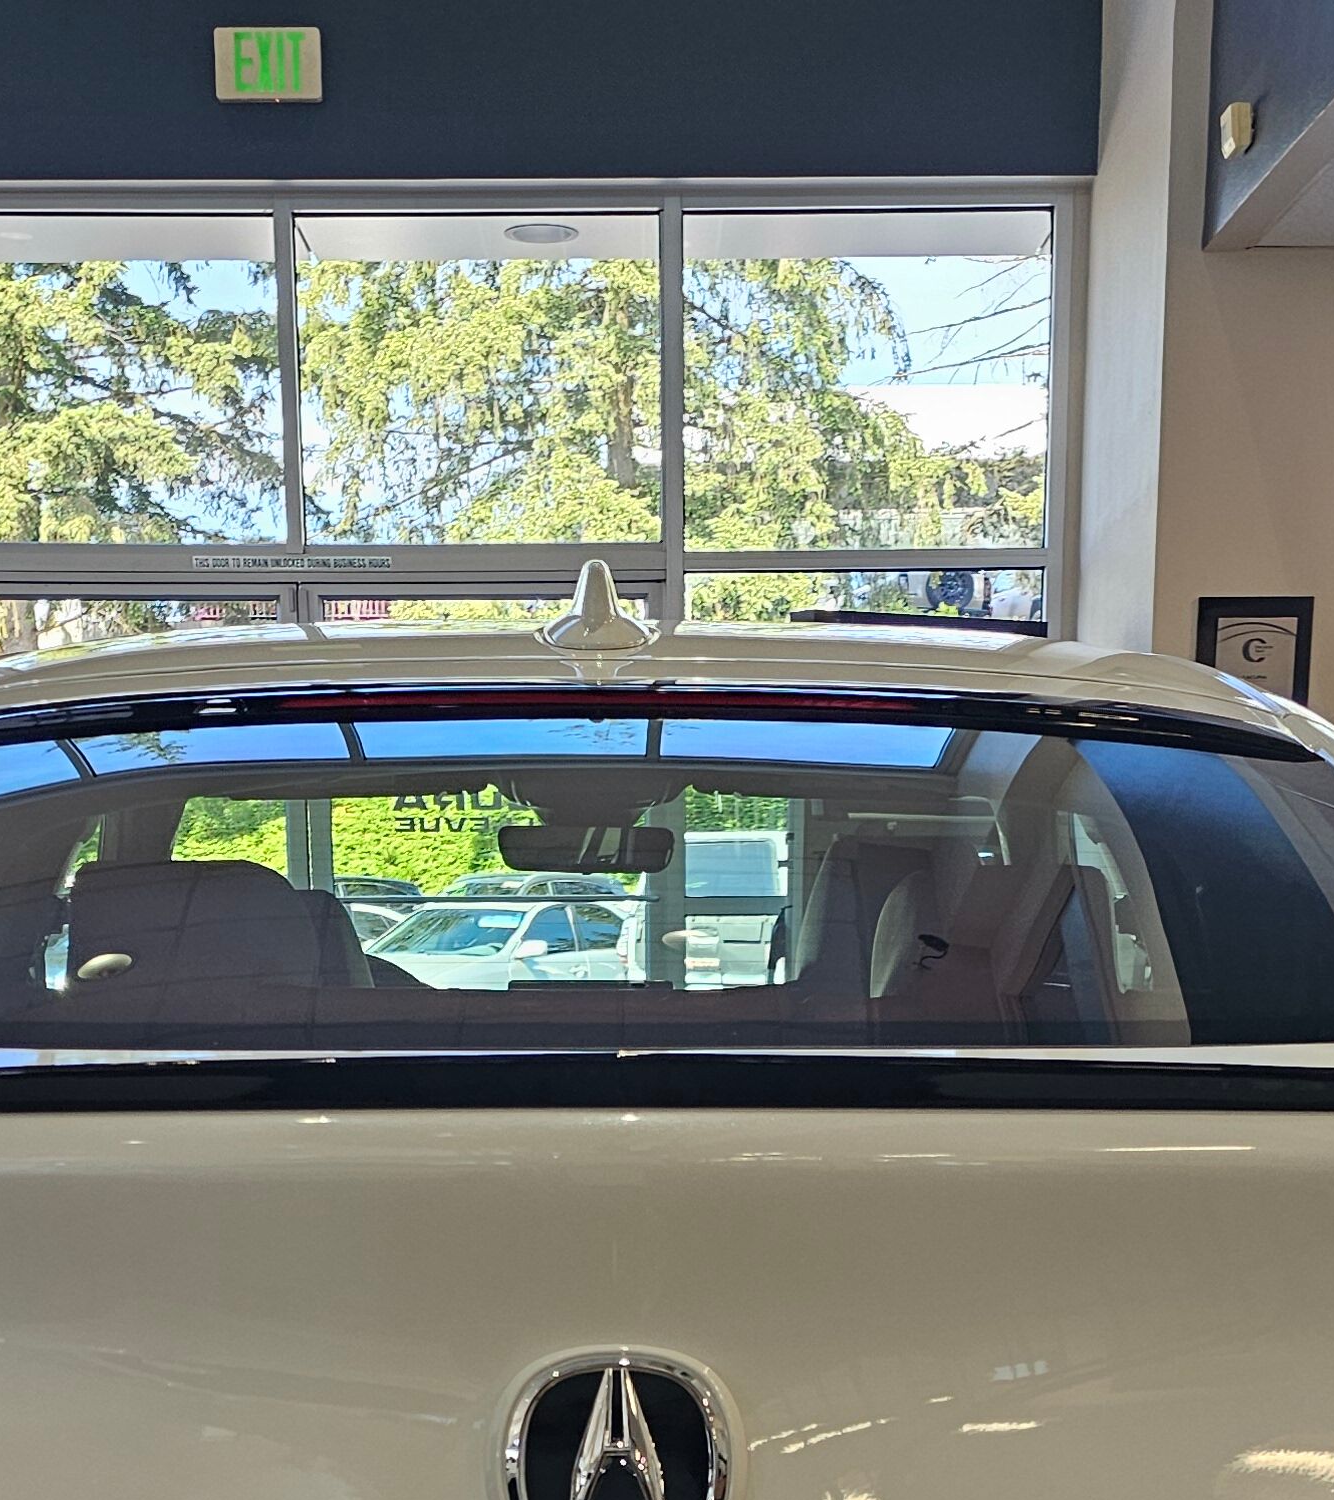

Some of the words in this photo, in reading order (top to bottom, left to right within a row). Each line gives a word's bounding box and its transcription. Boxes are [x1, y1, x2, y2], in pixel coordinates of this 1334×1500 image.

[234, 31, 305, 93] EXIT
[195, 558, 209, 568] THIS
[212, 558, 229, 568] DOOR
[232, 558, 241, 568] TO
[243, 558, 268, 568] REMAIN
[271, 558, 305, 568] UNLOCKED
[307, 558, 331, 568] DURING
[333, 558, 366, 568] BUSINESS
[368, 558, 390, 568] HOURS
